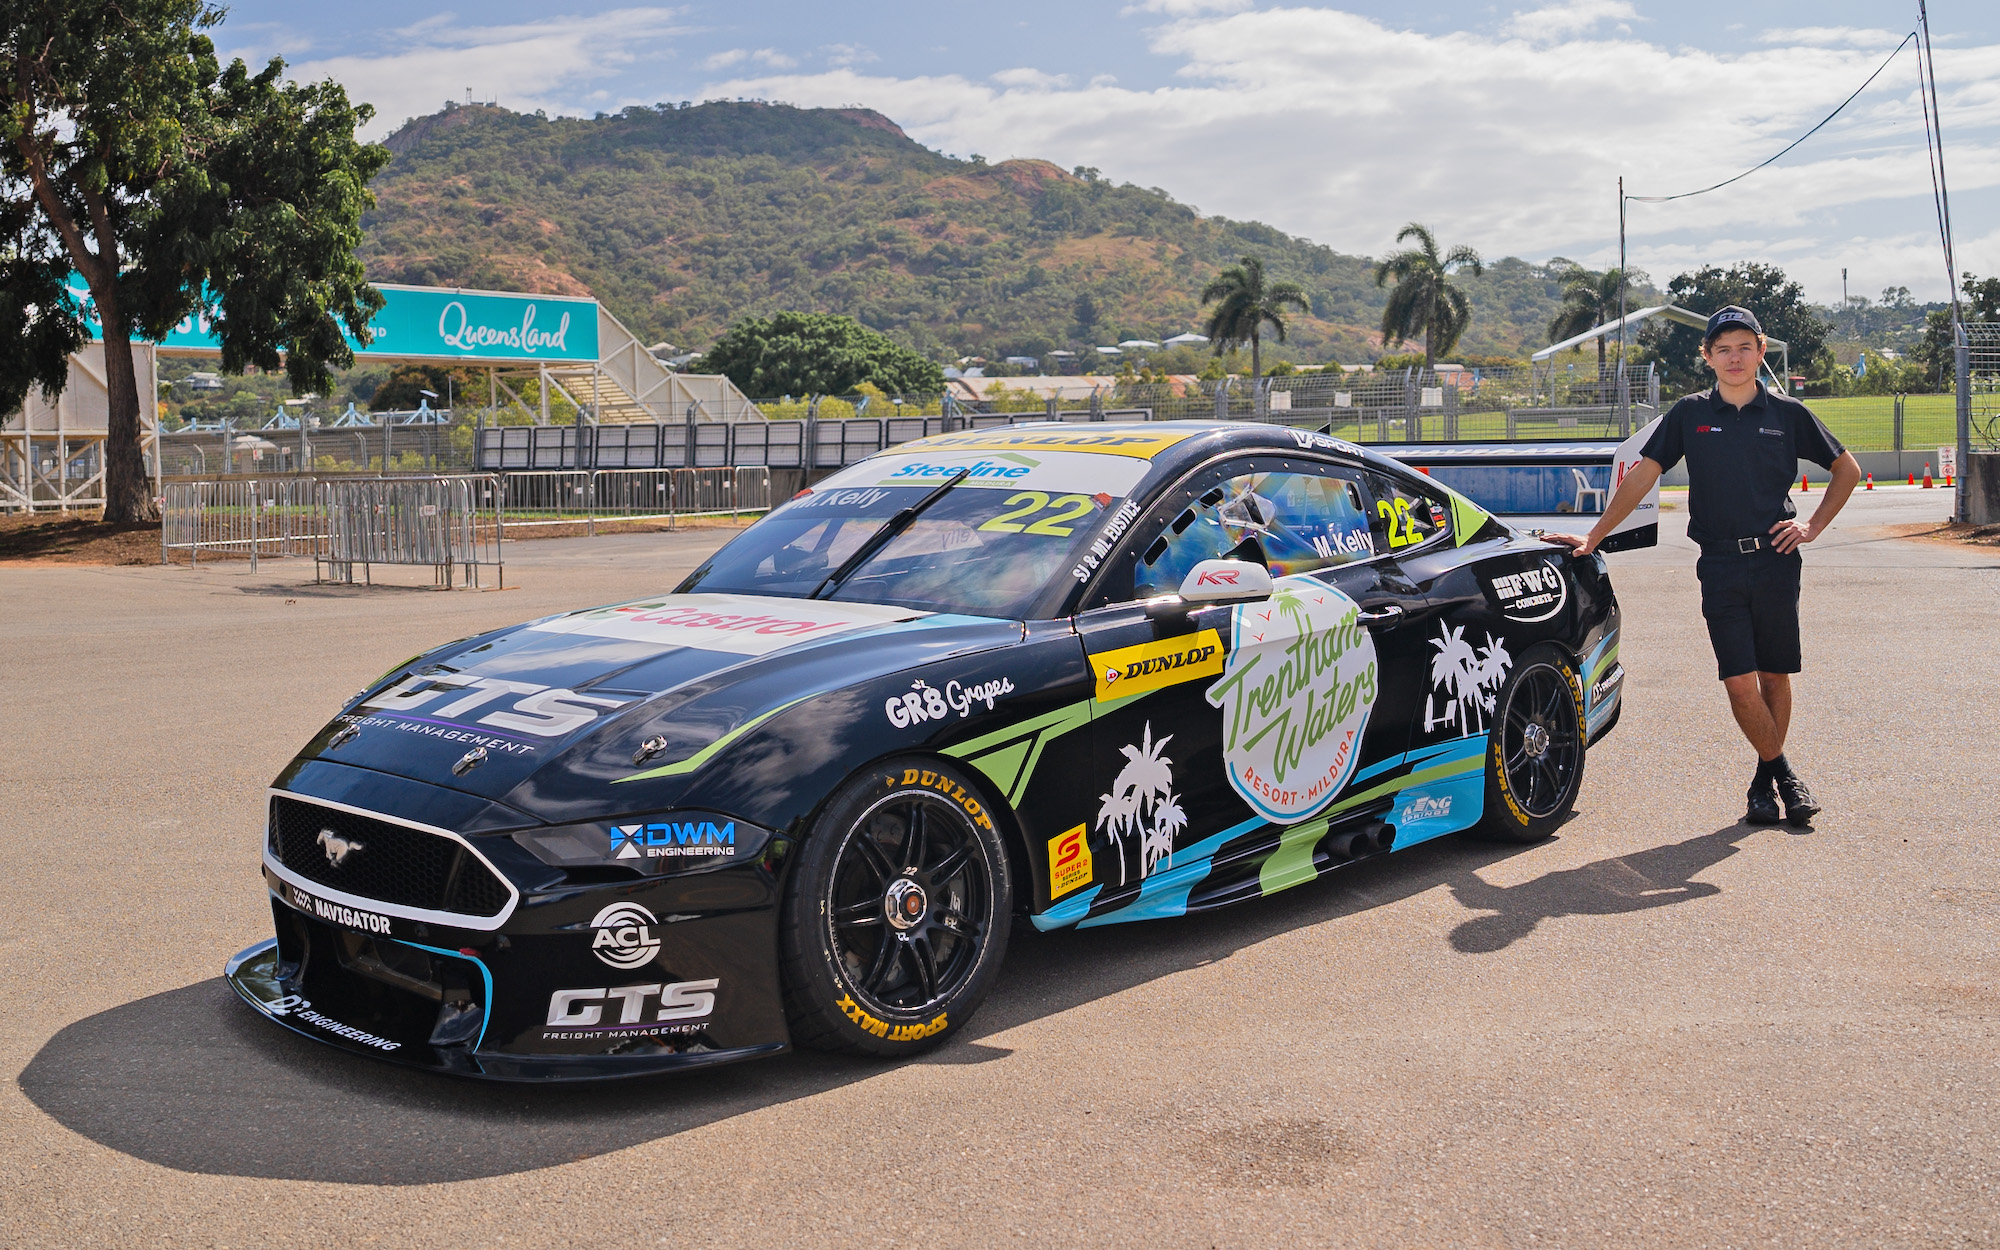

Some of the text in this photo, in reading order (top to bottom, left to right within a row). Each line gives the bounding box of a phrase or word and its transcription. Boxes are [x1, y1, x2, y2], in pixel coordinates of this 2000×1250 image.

[438, 301, 570, 353] Queensland
[926, 436, 1161, 447] DUNLOP
[890, 461, 1031, 478] Steeline
[977, 491, 1095, 537] 22
[1376, 497, 1425, 549] 22
[1072, 499, 1142, 584] SJ & ML EUSTICE
[1197, 570, 1240, 586] KR
[1516, 593, 1554, 609] CONCRETE
[630, 607, 852, 637] Castrol
[1123, 645, 1215, 680] DUNLOP
[1210, 606, 1363, 753] Trentham
[361, 673, 629, 737] GTS
[884, 676, 1015, 729] GR8 Grapes
[1562, 665, 1587, 748] DUNLOP
[335, 714, 535, 756] FREIGHT MANAGEMENT
[1242, 661, 1375, 785] Waters
[1244, 730, 1355, 806] RESORT MILDURA
[901, 768, 992, 830] DUNLOP
[646, 821, 735, 846] DWM
[646, 846, 735, 858] ENGINEERING
[902, 866, 918, 876] 22
[1055, 859, 1088, 880] SUPER 2
[1060, 872, 1088, 889] DUNLOP
[1062, 869, 1081, 881] SERIES
[314, 898, 392, 935] NAVIGATOR
[591, 925, 661, 949] ACL
[546, 978, 720, 1026] GTS
[836, 993, 949, 1042] SPORT MAXX
[298, 1010, 402, 1051] ENGINEERING
[542, 1022, 710, 1040] FREIGHT MANAGEMENT
